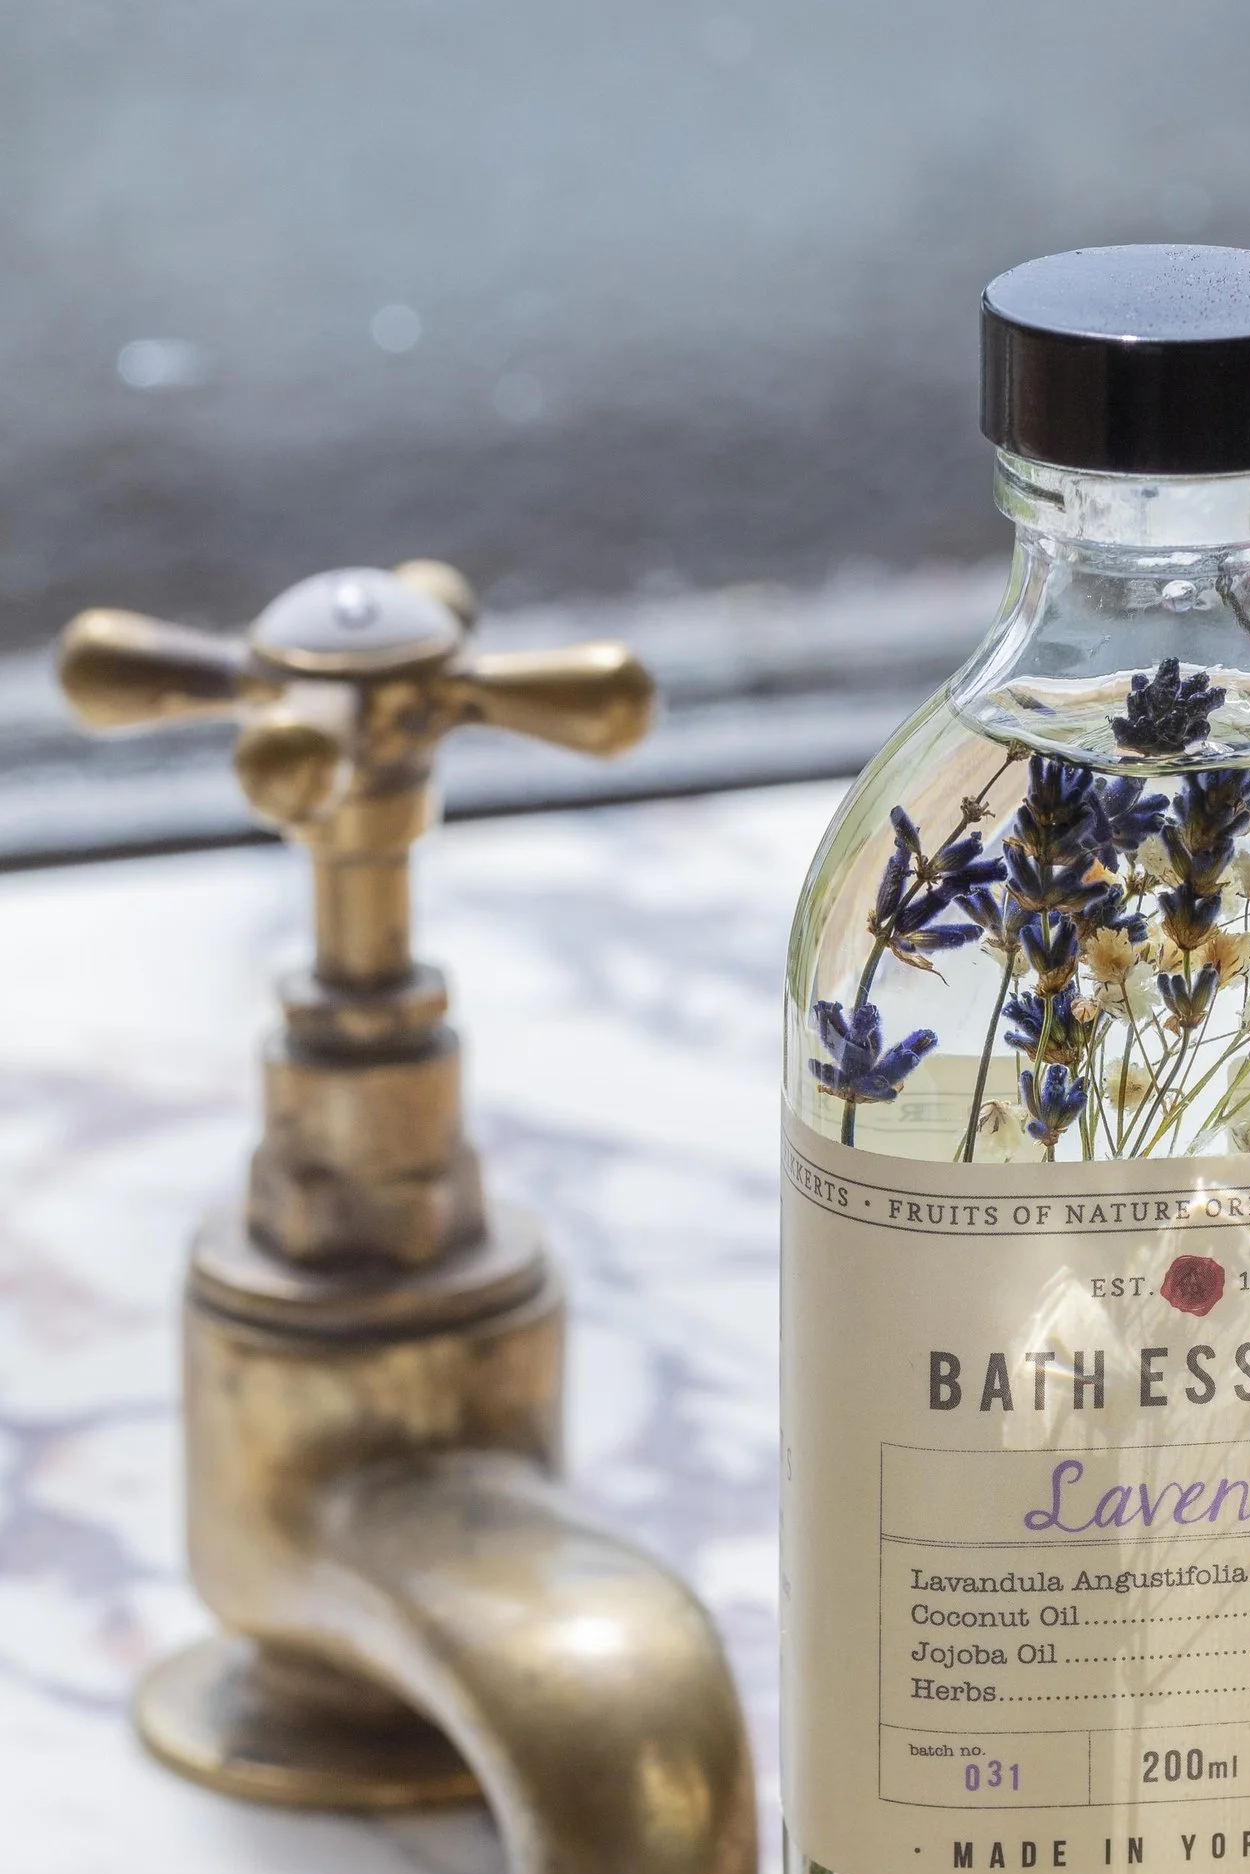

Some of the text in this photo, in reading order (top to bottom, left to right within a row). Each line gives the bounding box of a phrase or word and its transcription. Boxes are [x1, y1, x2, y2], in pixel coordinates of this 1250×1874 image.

[888, 1200, 999, 1226] FRUITS
[1012, 1205, 1052, 1226] OF
[1065, 1199, 1191, 1225] NATURE
[1091, 1276, 1155, 1299] EST.
[929, 1349, 1106, 1412] BATH
[911, 1562, 1248, 1595] Lavandula Angustifolia
[911, 1604, 1029, 1629] Coconut
[911, 1640, 1058, 1670] Jojoba Oil
[909, 1742, 986, 1758] batch no.
[964, 1761, 1021, 1791] 031
[1141, 1750, 1239, 1784] 200ml
[952, 1839, 1068, 1870] MADE
[1105, 1836, 1144, 1866] IN
